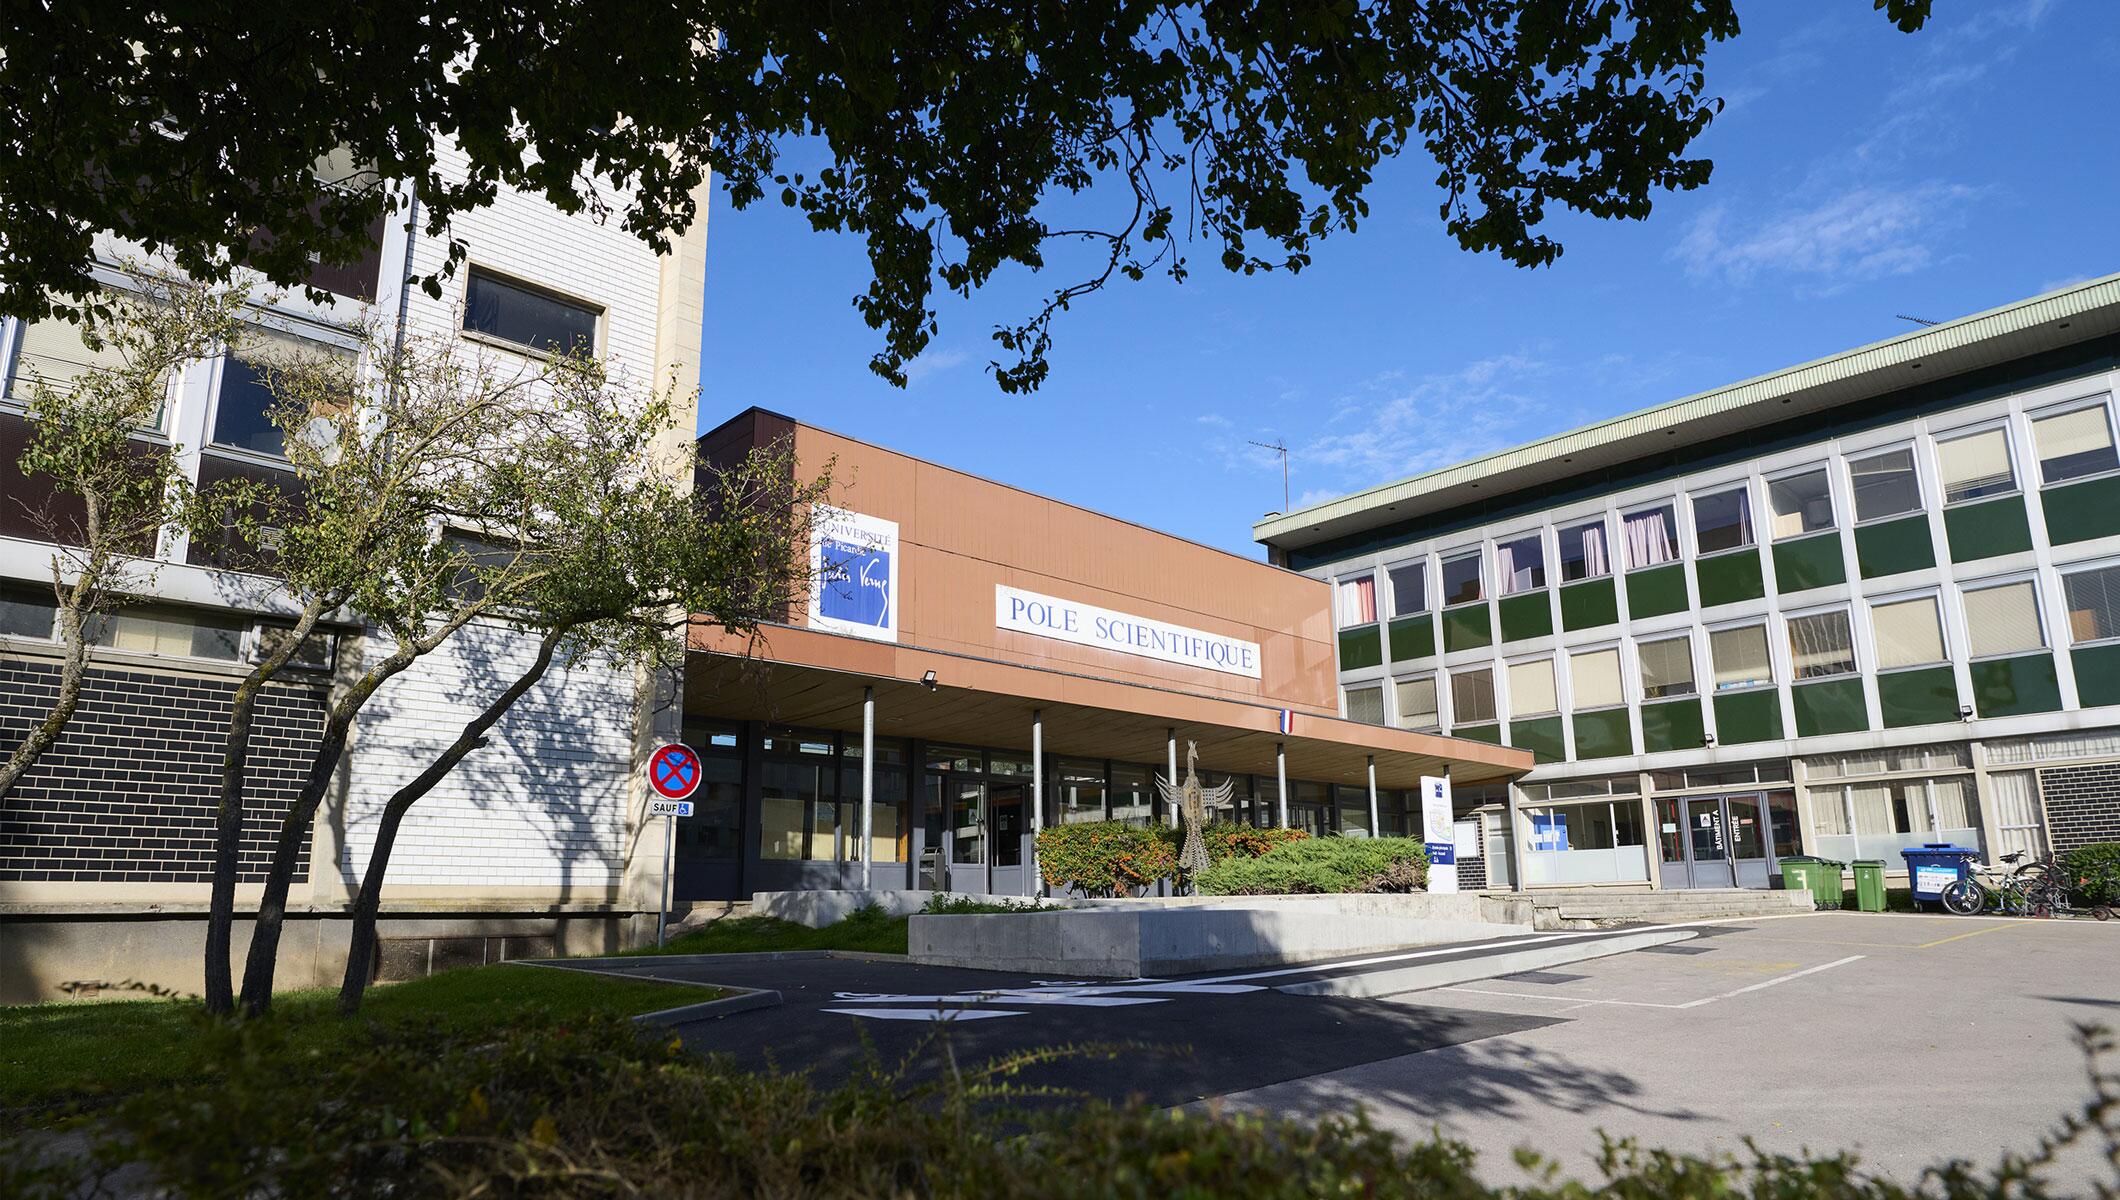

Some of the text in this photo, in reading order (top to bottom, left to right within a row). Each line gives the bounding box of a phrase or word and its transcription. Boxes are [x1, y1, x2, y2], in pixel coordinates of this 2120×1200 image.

[1010, 597, 1254, 669] POLE SCIENTIFIQUE
[653, 803, 677, 812] SAUF
[1731, 816, 1741, 842] ENTRÉE
